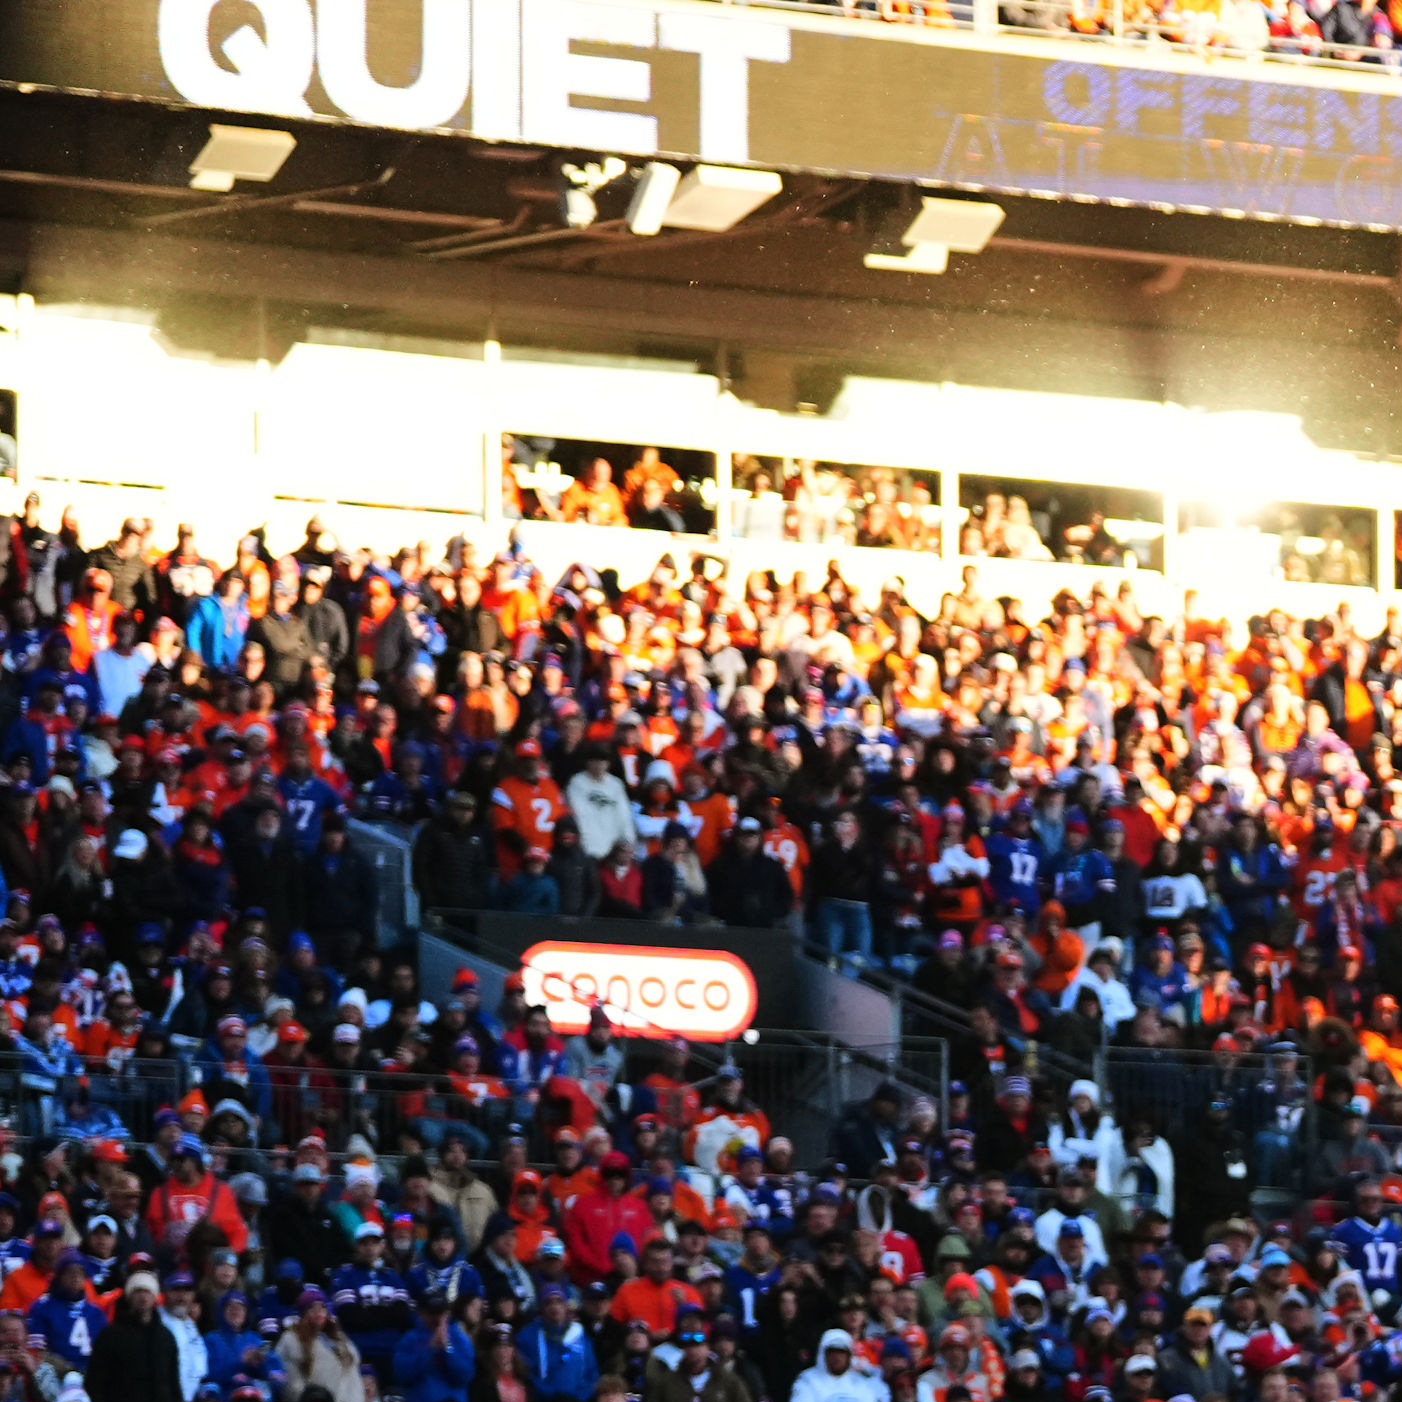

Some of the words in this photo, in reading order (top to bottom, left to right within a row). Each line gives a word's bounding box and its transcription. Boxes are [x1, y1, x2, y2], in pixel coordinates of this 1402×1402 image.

[159, 0, 791, 163] QUIET
[532, 798, 555, 831] 2
[542, 973, 730, 1011] conoco
[1361, 1242, 1399, 1280] 17
[70, 1317, 93, 1356] 4
